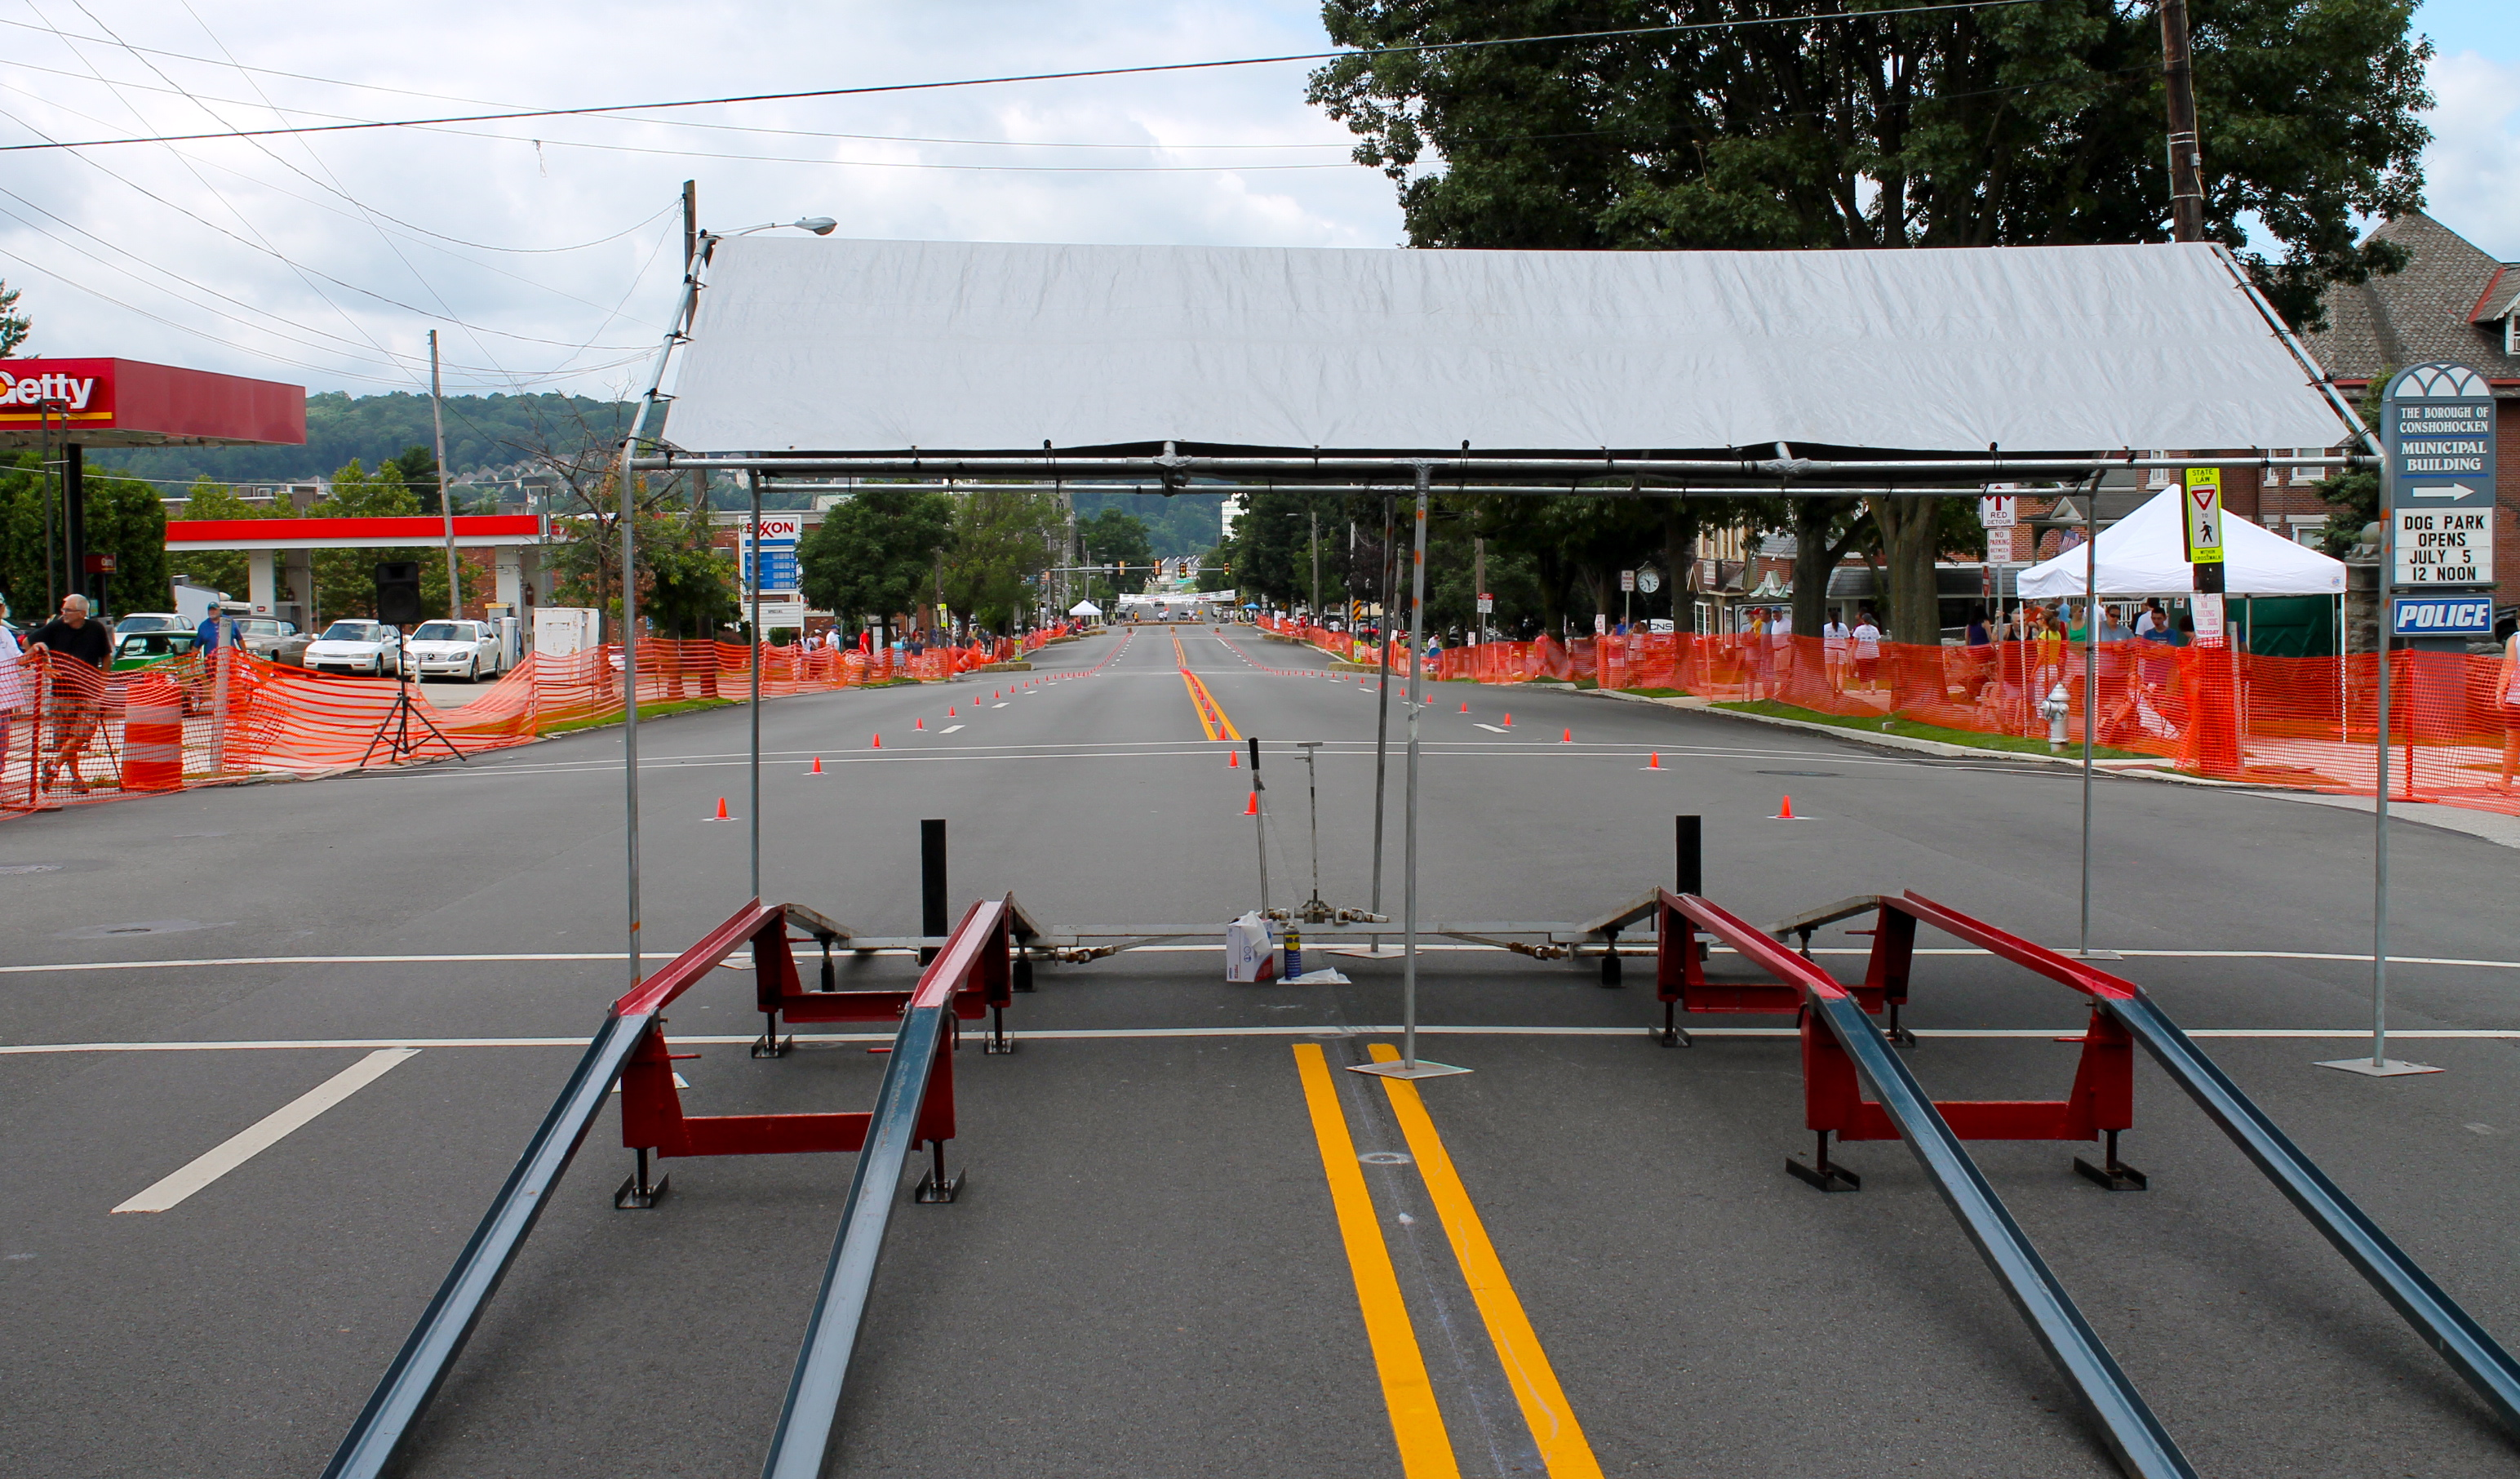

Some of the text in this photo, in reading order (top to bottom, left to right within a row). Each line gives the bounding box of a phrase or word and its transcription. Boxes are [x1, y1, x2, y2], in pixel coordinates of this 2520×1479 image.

[2401, 406, 2488, 419] THE BOROUGH OF
[2399, 420, 2488, 433] CONSHOHOCKEN
[2401, 441, 2487, 455] MUNICIPAL
[2407, 457, 2482, 471] BUILDING
[2404, 515, 2484, 530] DOG PARK
[2418, 532, 2466, 547] OPENS
[2409, 549, 2472, 564] JULY 5
[2412, 566, 2476, 581] 12 NOON
[2397, 604, 2489, 628] POLICE
